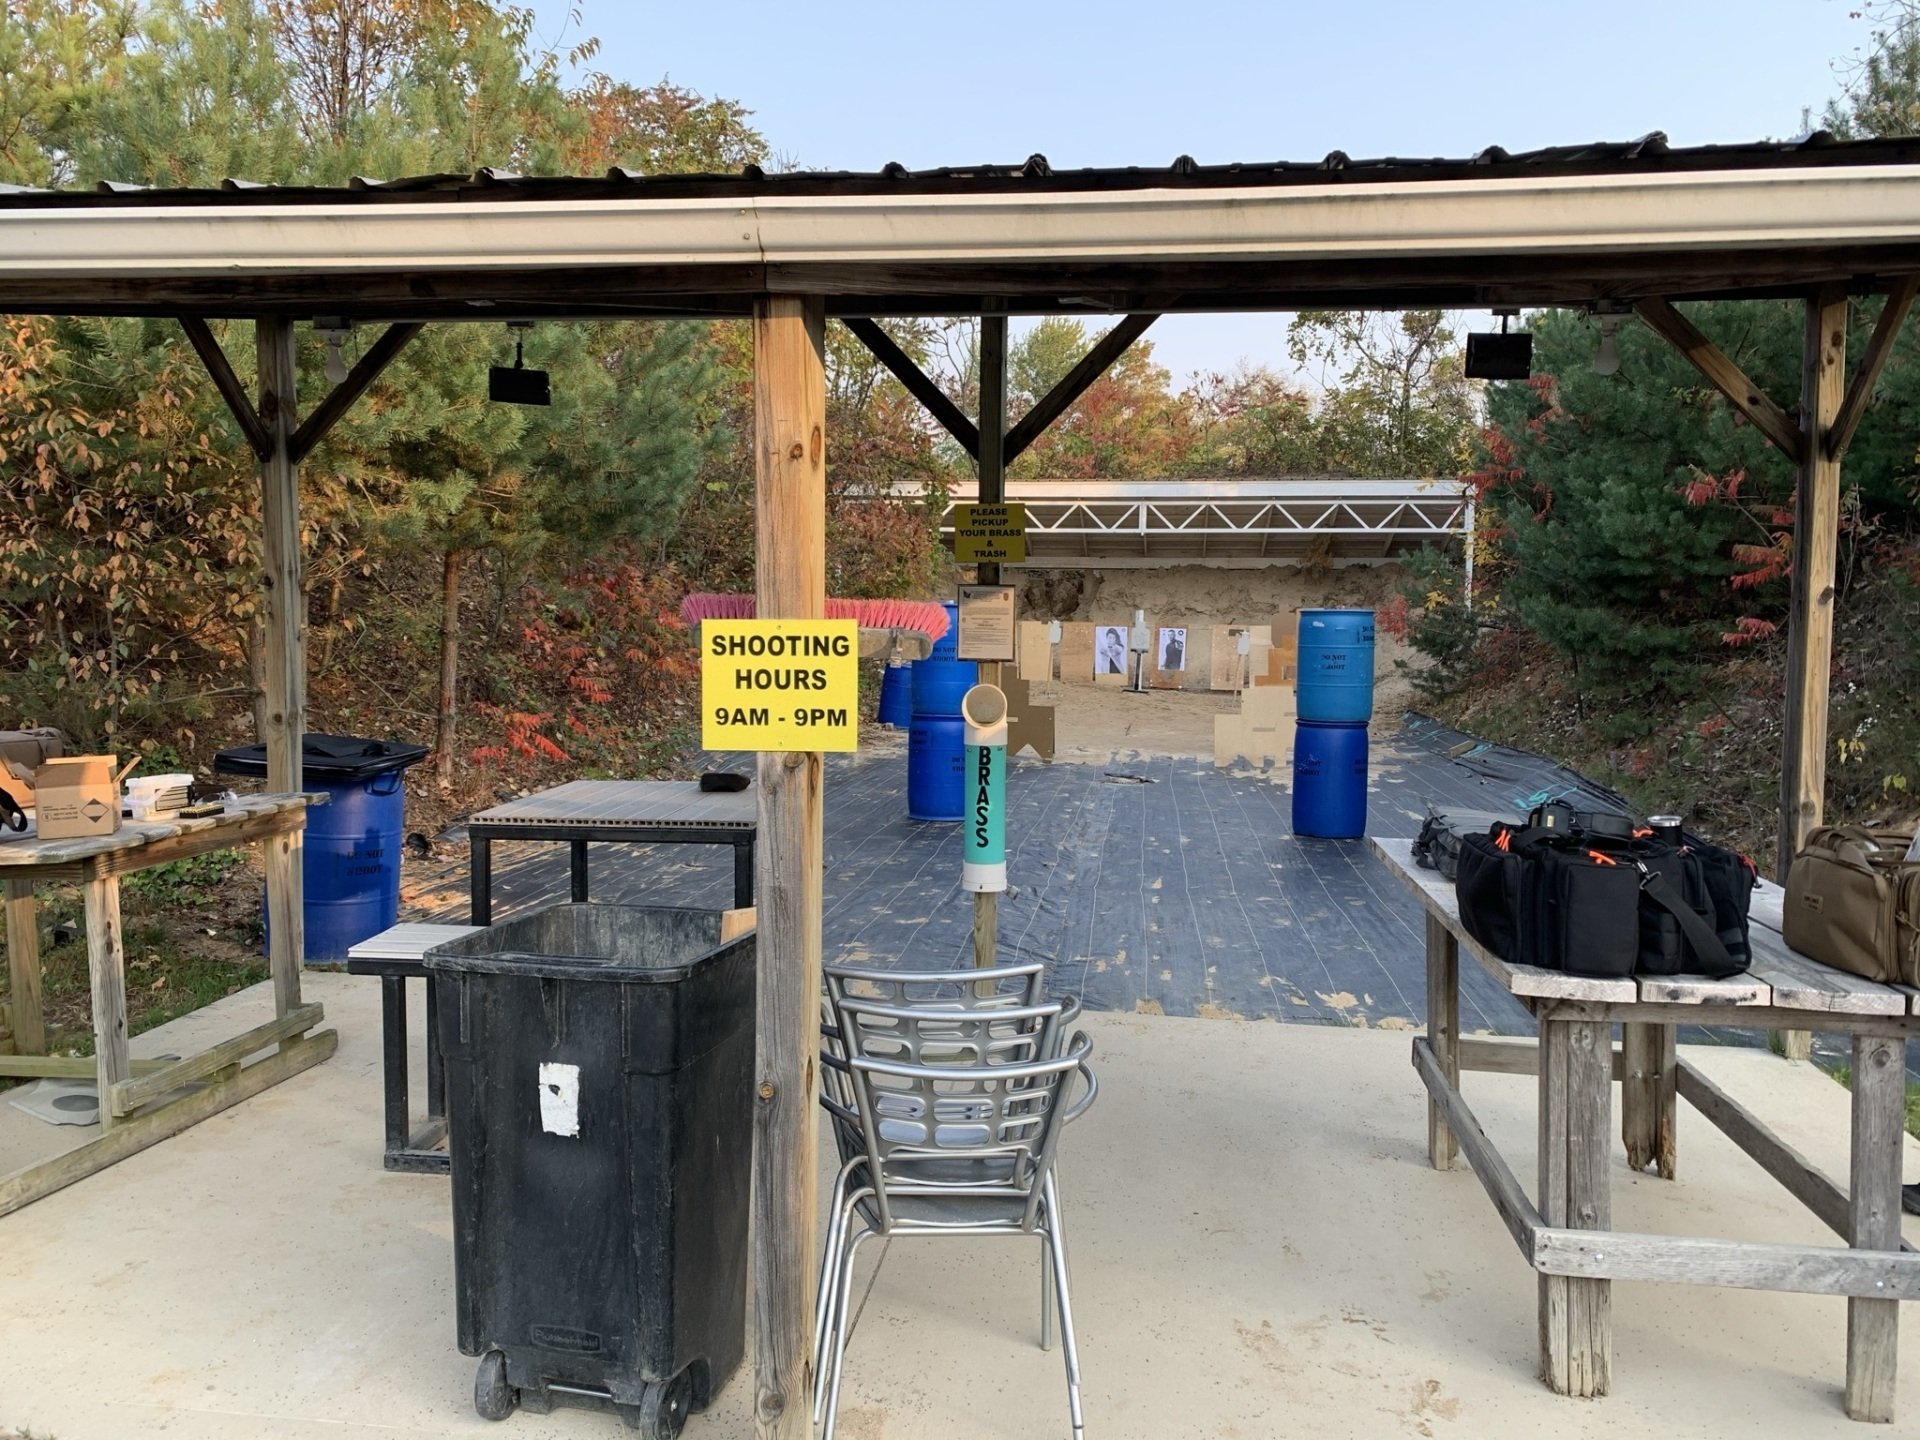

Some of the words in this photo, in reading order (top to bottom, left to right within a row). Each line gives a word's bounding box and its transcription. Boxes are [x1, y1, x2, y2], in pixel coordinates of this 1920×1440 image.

[969, 507, 1008, 516] PLEASE
[971, 518, 1009, 527] PICKUP
[959, 529, 986, 537] YOUR
[988, 528, 1022, 537] BRASS
[986, 539, 994, 547] &
[973, 550, 1007, 558] TRASH
[711, 634, 850, 657] SHOOTING
[735, 668, 827, 691] HOURS
[714, 707, 769, 726] 9AM
[793, 708, 848, 727] 9PM
[975, 745, 992, 848] BRASS
